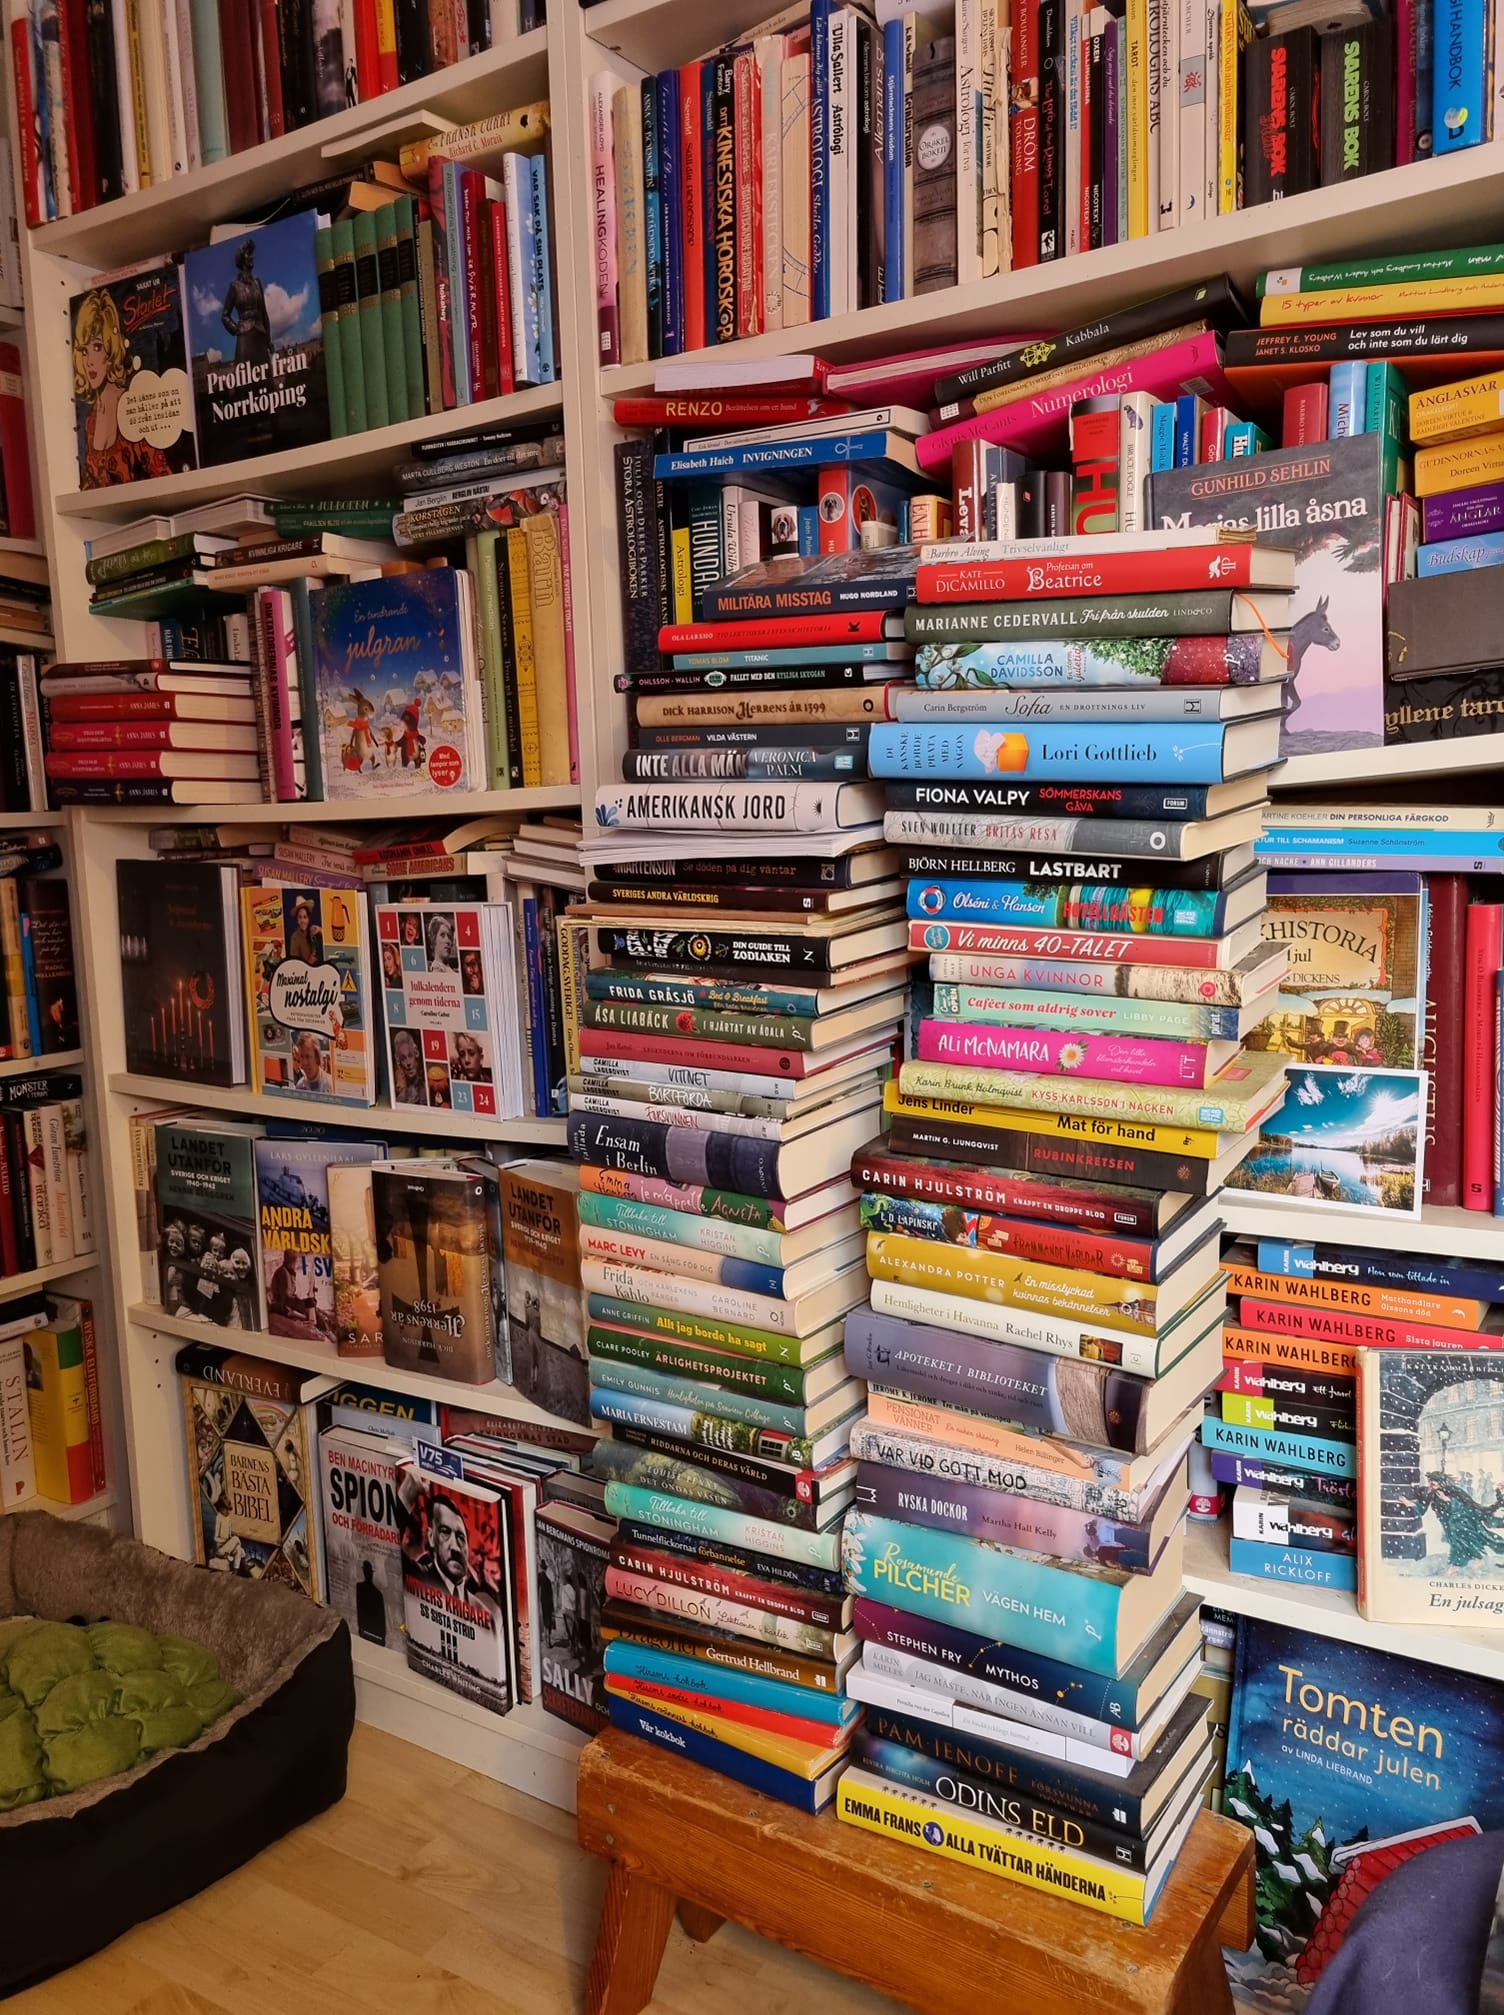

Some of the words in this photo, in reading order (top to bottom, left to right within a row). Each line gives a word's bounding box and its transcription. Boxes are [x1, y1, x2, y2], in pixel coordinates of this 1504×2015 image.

[831, 23, 843, 46] Ulla
[831, 51, 844, 93] Sallert
[831, 104, 844, 155] Astrologi
[811, 98, 824, 189] ASTROLOGI
[1024, 117, 1036, 173] DRÖM
[717, 125, 733, 227] KINESISKA
[536, 219, 542, 236] PÅ
[595, 165, 608, 298] HEALINGKODEN
[536, 258, 544, 291] PLATS
[1256, 335, 1290, 346] JEFFREY
[1293, 334, 1300, 343] E.
[1304, 332, 1337, 342] YOUNG
[1348, 341, 1366, 350] och
[1368, 339, 1387, 348] inte
[1390, 338, 1412, 347] som
[1415, 336, 1428, 345] du
[1430, 334, 1448, 344] lärt
[1451, 333, 1468, 346] dig
[1350, 329, 1367, 339] Lev
[1371, 328, 1391, 337] som
[1393, 326, 1406, 336] du
[1410, 325, 1425, 334] vill
[958, 372, 979, 386] Will
[980, 360, 1011, 379] Parfitt
[1065, 324, 1110, 347] Kabbala
[207, 362, 269, 395] Profiler
[272, 349, 308, 376] från
[212, 384, 307, 424] Norrköping
[1030, 367, 1134, 418] Numerologi
[666, 401, 722, 417] RENZO
[622, 456, 633, 484] STORA
[671, 457, 708, 470] Elisabeth
[710, 455, 734, 468] Haich
[742, 448, 813, 464] INVIGNINGEN
[1191, 473, 1266, 497] GUNHILD
[1270, 459, 1331, 484] SEHLIN
[1255, 503, 1300, 529] lilla
[1306, 496, 1368, 524] åsna
[276, 541, 303, 554] KRIGARE
[624, 486, 639, 599] ASTROLOGIBOKEN
[1027, 566, 1102, 592] Beatrice
[718, 591, 772, 611] MILITÄRA
[776, 591, 832, 607] MISSTAG
[840, 592, 859, 600] HUGO
[861, 590, 898, 599] NORDLAND
[915, 616, 988, 631] MARIANNE
[993, 611, 1078, 628] CEDERVALL
[1100, 608, 1125, 624] från
[1126, 607, 1169, 619] skulden
[990, 665, 1063, 679] DAVIDSSON
[997, 654, 1054, 666] CAMILLA
[706, 733, 725, 742] VILDA
[727, 732, 757, 741] VÄSTERN
[636, 754, 669, 777] INTE
[672, 754, 706, 776] ALLA
[711, 750, 746, 776] MÄN
[1042, 745, 1078, 761] Lori
[1085, 744, 1157, 762] Gottlieb
[627, 794, 736, 819] AMERIKANSK
[742, 794, 785, 819] JORD
[915, 788, 969, 804] FIONA
[973, 788, 1030, 807] VALPY
[1039, 787, 1122, 801] SÖMMERSKANS
[1065, 799, 1094, 813] GÅVA
[1330, 813, 1346, 822] DIN
[1348, 813, 1403, 824] PERSONLIGA
[1405, 812, 1449, 824] FÄRGKOD
[908, 856, 948, 871] BJÖRN
[950, 859, 1016, 874] HELLBERG
[1029, 861, 1122, 879] LASTBART
[612, 889, 645, 899] SVERIGES
[646, 890, 672, 900] ANDRA
[673, 891, 719, 903] VÄRLDSKRIG
[733, 950, 791, 963] ZODIAKEN
[957, 929, 973, 947] Vi
[977, 935, 1029, 952] minns
[1034, 935, 1133, 958] 40-TALET
[410, 981, 456, 995] Julkalendern
[969, 966, 1017, 980] UNGA
[1023, 968, 1104, 988] KVINNOR
[283, 986, 340, 1012] nostalgi
[609, 985, 643, 999] FRIDA
[649, 986, 696, 1004] GRÅSJÖ
[595, 1006, 616, 1023] ÅSA
[620, 1009, 669, 1029] LIABÄCK
[668, 1069, 711, 1086] VITTNET
[931, 1097, 975, 1116] Linder
[1057, 1113, 1088, 1132] Mat
[1090, 1116, 1112, 1136] för
[1117, 1121, 1156, 1142] hand
[172, 1136, 225, 1156] LANDET
[595, 1125, 640, 1152] Ensam
[1034, 1148, 1135, 1171] RUBINKRETSEN
[510, 1182, 554, 1211] LANDET
[862, 1168, 907, 1188] CARIN
[915, 1174, 1007, 1204] HJULSTRÖM
[262, 1205, 313, 1229] ANDRA
[509, 1202, 561, 1235] UTANFÖR
[588, 1238, 618, 1254] MARC
[620, 1243, 646, 1260] LEVY
[879, 1255, 951, 1278] ALEXANDRA
[956, 1270, 1006, 1289] POTTER
[1293, 1258, 1359, 1276] wahlberg
[1234, 1274, 1280, 1293] KARIN
[1285, 1281, 1372, 1308] WAHLBERG
[1005, 1322, 1043, 1343] Rachel
[1046, 1331, 1074, 1349] Rhys
[1256, 1310, 1303, 1329] KARIN
[1309, 1318, 1397, 1343] WAHLBERG
[655, 1350, 767, 1386] ÄRLIGHETSPROJEKTET
[601, 1405, 631, 1422] MARIA
[633, 1410, 688, 1434] ERNESTAM
[420, 1442, 442, 1465] V75
[651, 1438, 691, 1457] RIDDARNA
[693, 1449, 710, 1462] OCH
[712, 1456, 738, 1472] DERAS
[740, 1465, 768, 1481] VÄRLD
[1215, 1428, 1259, 1449] KARIN
[1264, 1437, 1347, 1468] WAHLBERG
[230, 1454, 270, 1472] BARNENS
[232, 1470, 271, 1496] BÄSTA
[330, 1467, 400, 1526] SPION
[233, 1493, 274, 1524] BIBEL
[898, 1491, 928, 1514] RYSKA
[931, 1500, 969, 1522] DOCKOR
[632, 1529, 697, 1553] Tunnelflickornas
[1264, 1562, 1332, 1583] RICKLOFF
[1282, 1552, 1314, 1567] ALIX
[874, 1559, 971, 1608] PILCHER
[615, 1581, 652, 1600] LUCY
[657, 1593, 711, 1620] DILLON
[982, 1590, 1030, 1617] VÄGEN
[1033, 1607, 1067, 1627] HEM
[887, 1630, 938, 1655] STEPHEN
[940, 1647, 962, 1664] FRY
[706, 1647, 747, 1668] Gertrud
[748, 1658, 800, 1681] Hellbrand
[985, 1663, 1040, 1690] MYTHOS
[542, 1658, 594, 1706] SALLY
[1278, 1664, 1443, 1759] Tomten
[639, 1719, 654, 1733] Vår
[655, 1726, 686, 1748] kokbok
[1280, 1746, 1293, 1755] av
[1296, 1748, 1324, 1768] LINDA
[1326, 1761, 1373, 1785] LIEBRAND
[1283, 1716, 1369, 1762] räddar
[1373, 1751, 1441, 1791] julen
[935, 1775, 1021, 1825] ODINS
[1032, 1808, 1085, 1847] ELD
[845, 1797, 881, 1823] EMMA
[883, 1810, 921, 1837] FRANS
[946, 1836, 975, 1857] ALLA
[978, 1839, 1033, 1875] TVÄTTAR
[1036, 1862, 1106, 1902] HÄNDERNA
